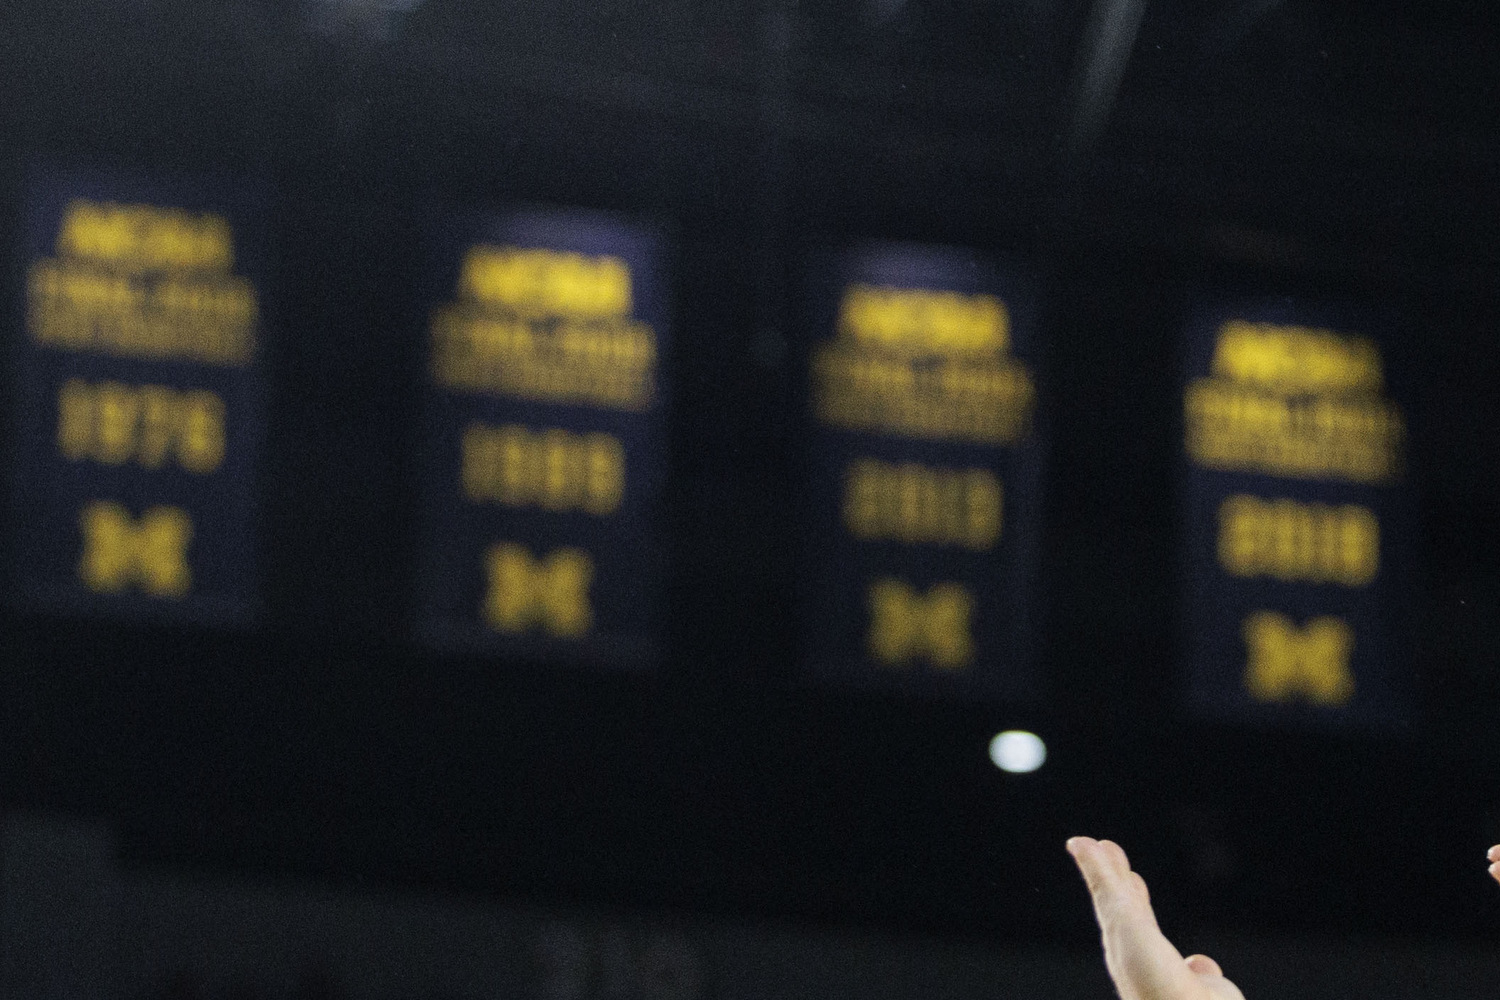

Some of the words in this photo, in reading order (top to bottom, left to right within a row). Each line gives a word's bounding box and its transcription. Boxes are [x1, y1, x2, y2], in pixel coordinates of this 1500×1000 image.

[80, 501, 193, 596] M
[484, 541, 595, 637] M
[867, 577, 974, 671] M
[1242, 611, 1354, 706] M
